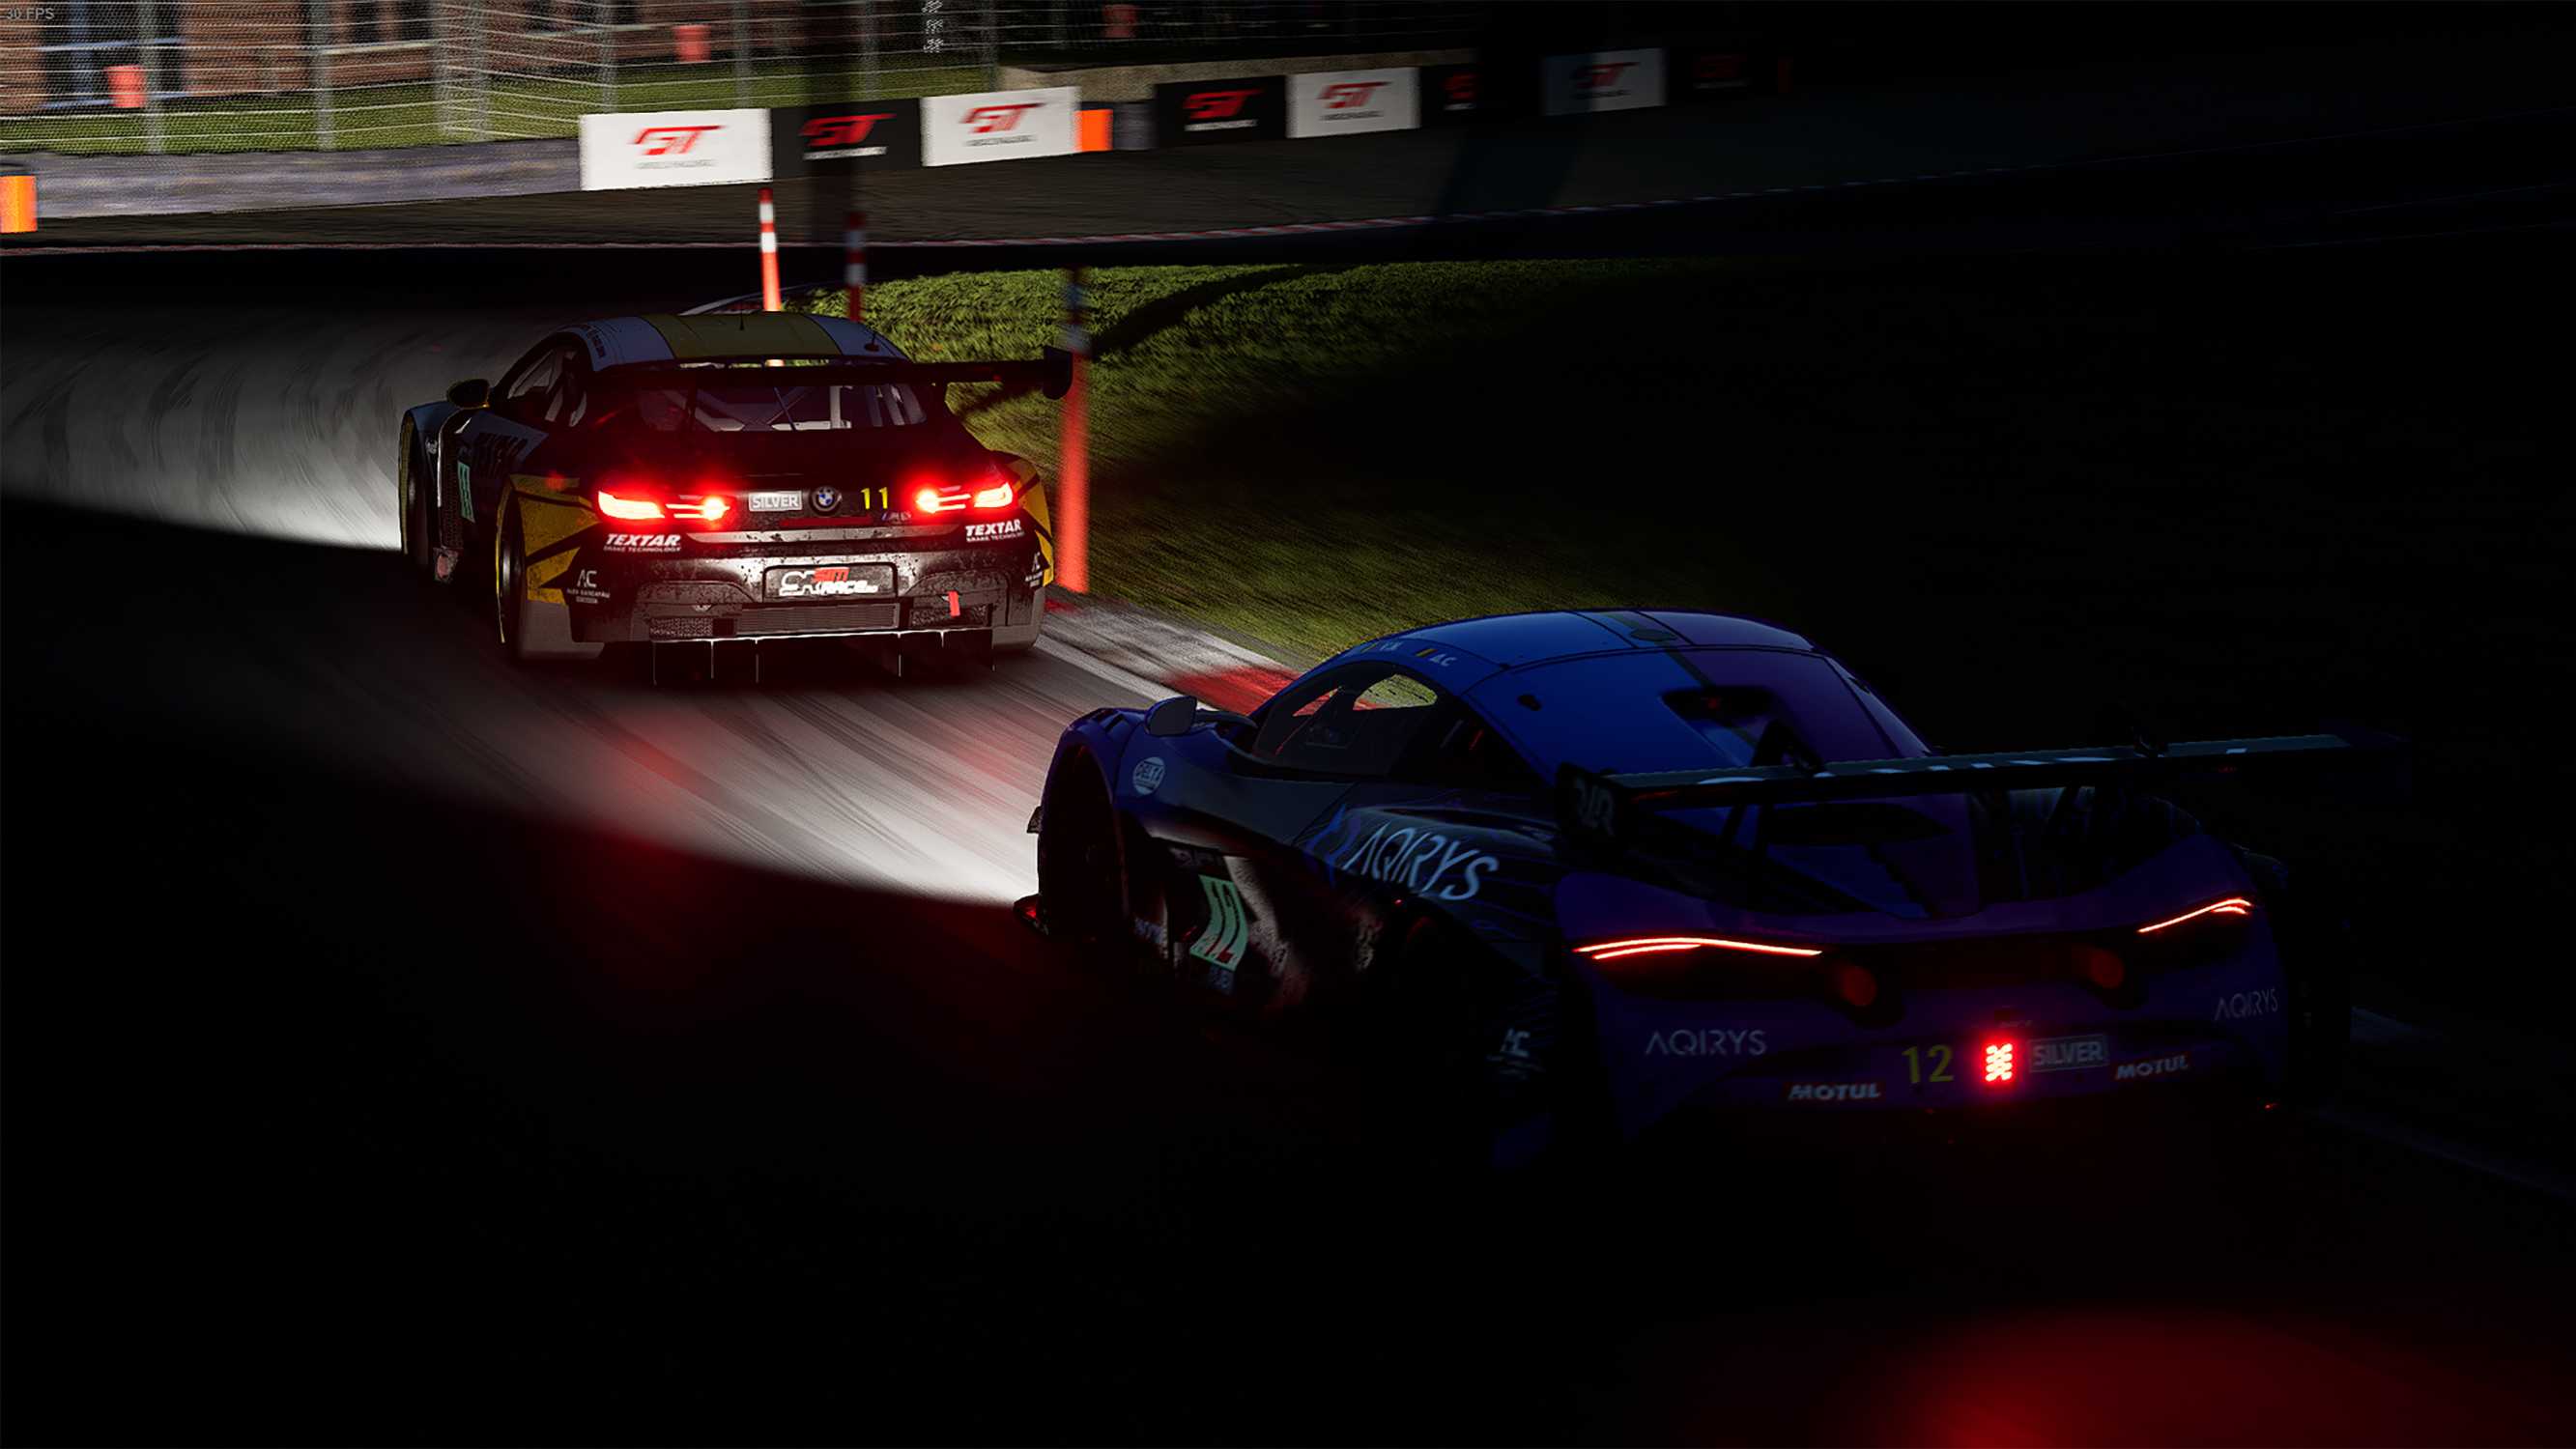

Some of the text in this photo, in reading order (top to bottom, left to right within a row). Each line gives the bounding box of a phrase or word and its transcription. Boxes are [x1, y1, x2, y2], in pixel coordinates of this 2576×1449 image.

[752, 496, 799, 508] SILVER
[861, 486, 888, 510] 11
[605, 533, 681, 547] TEXTAR
[964, 519, 1022, 537] TEXTAR
[1342, 821, 1499, 900] AQIRYS
[2214, 986, 2278, 1021] AQIRYS
[1645, 1028, 1768, 1058] AQIRYS
[2033, 1041, 2104, 1067] SILVER
[1901, 1043, 1955, 1083] 12
[2114, 1055, 2190, 1081] MOTUL
[1788, 1083, 1881, 1102] MOTUL
